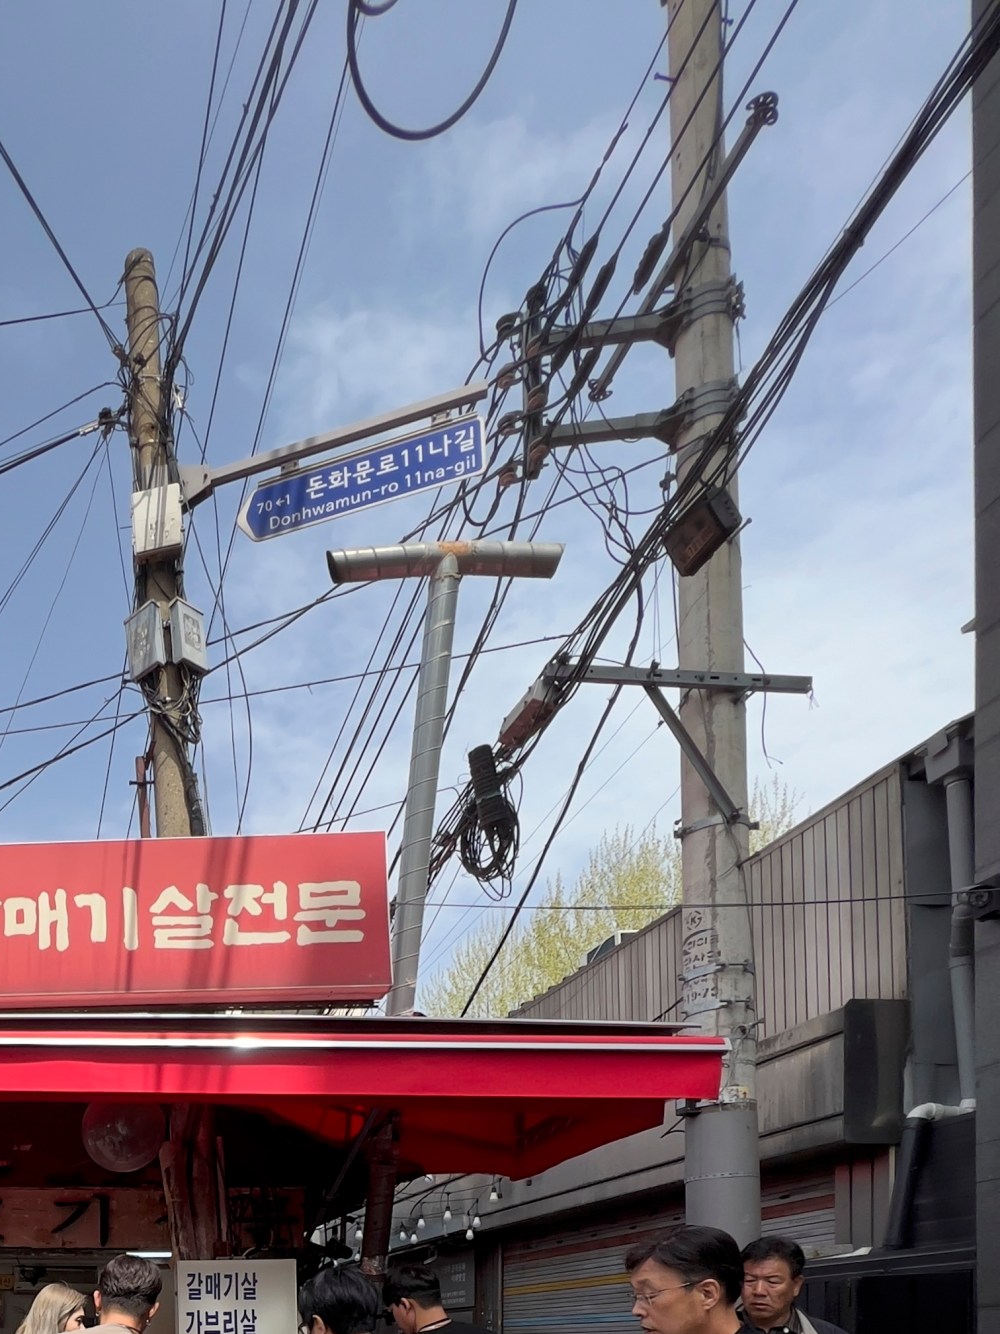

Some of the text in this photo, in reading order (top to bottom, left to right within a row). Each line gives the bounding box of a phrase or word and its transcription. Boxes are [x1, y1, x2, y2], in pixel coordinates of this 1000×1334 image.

[269, 454, 476, 530] Donhwamun-ro 11na-gil
[305, 425, 475, 499] 돈화문로11나길
[186, 1272, 258, 1301] 갈매기살
